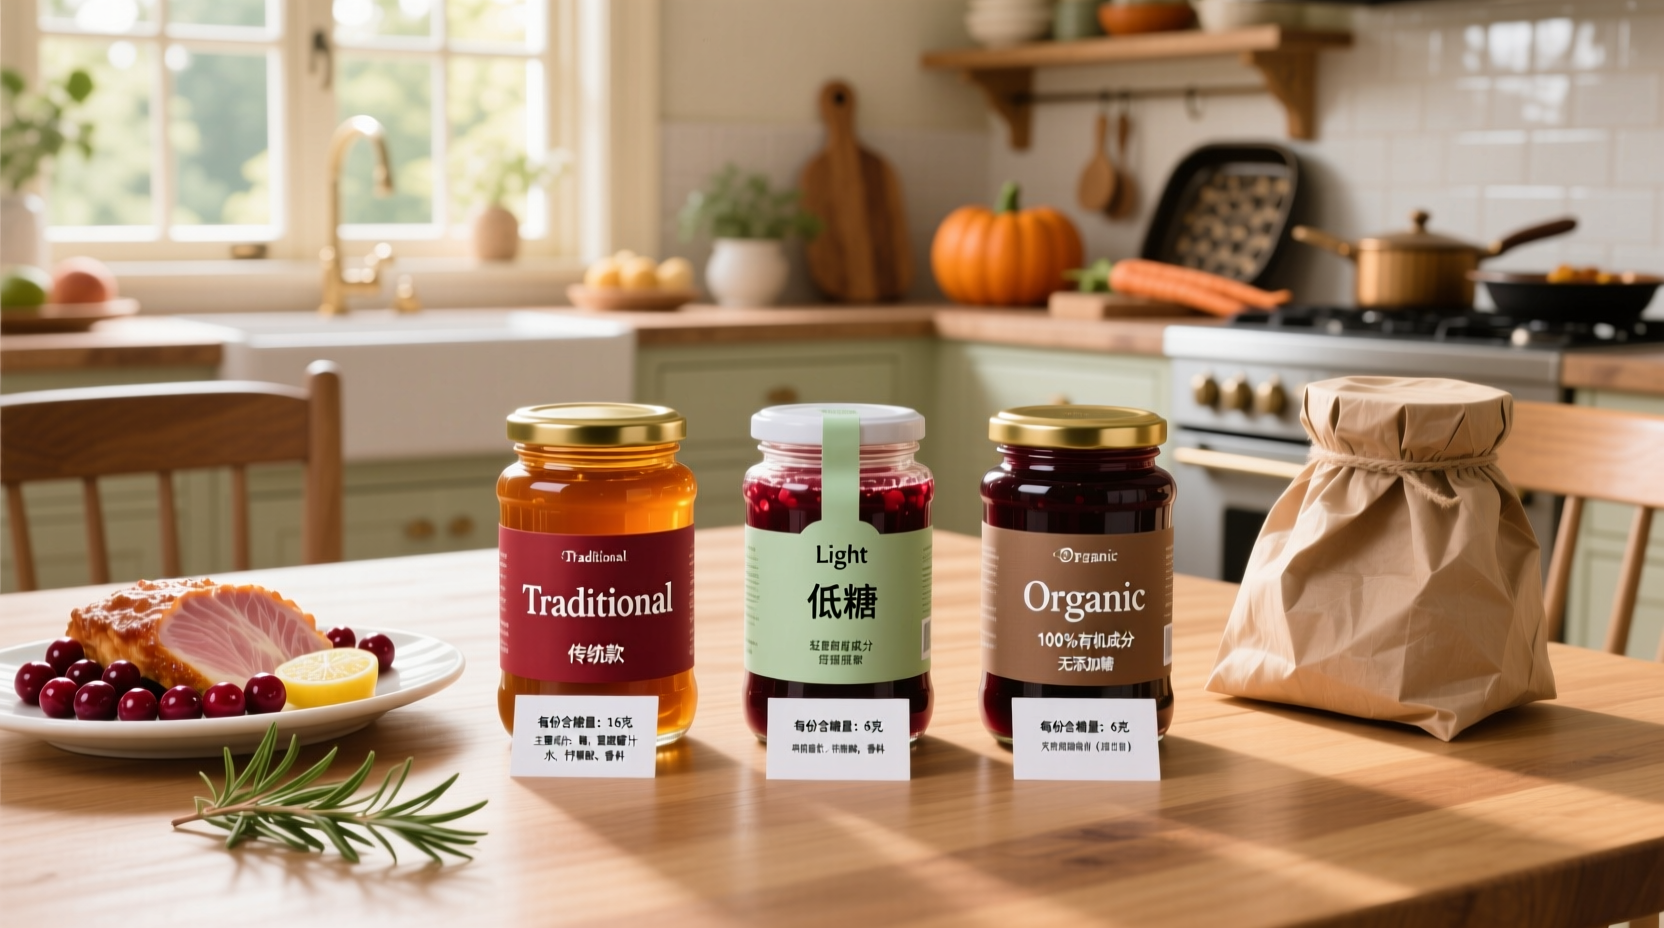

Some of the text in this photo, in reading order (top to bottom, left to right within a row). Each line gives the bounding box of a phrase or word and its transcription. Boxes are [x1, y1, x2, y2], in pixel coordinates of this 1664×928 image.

[816, 544, 868, 570] Light
[522, 581, 673, 617] Traditional
[807, 583, 878, 620] 低糖
[1023, 580, 1146, 623] Organic
[568, 643, 625, 664] 传统款
[1038, 631, 1135, 649] 100%有机成分
